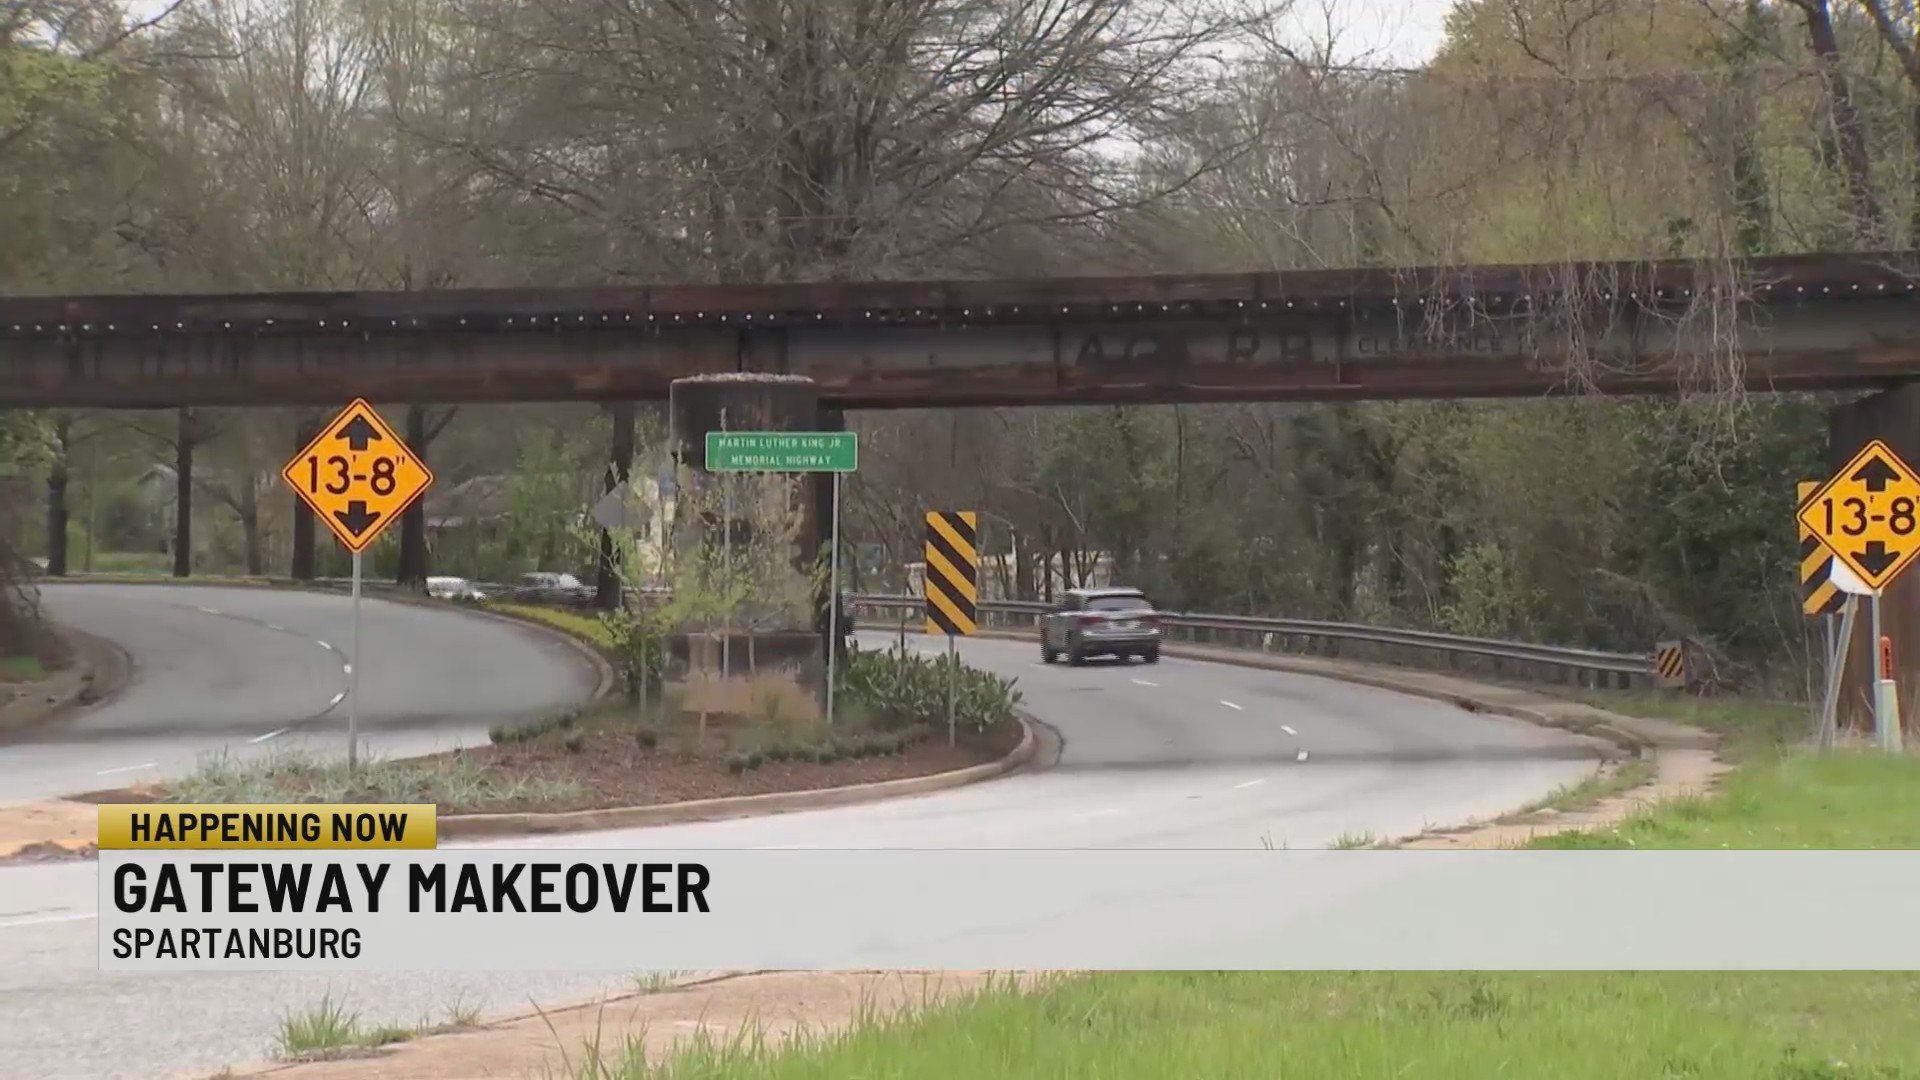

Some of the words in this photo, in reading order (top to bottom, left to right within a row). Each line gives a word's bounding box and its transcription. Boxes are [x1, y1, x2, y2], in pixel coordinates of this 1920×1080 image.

[718, 438, 756, 448] MARTIN
[759, 438, 798, 448] LUTHER
[801, 438, 824, 448] KING
[731, 455, 780, 466] MEMORIAL
[785, 455, 832, 465] HIGHWAY
